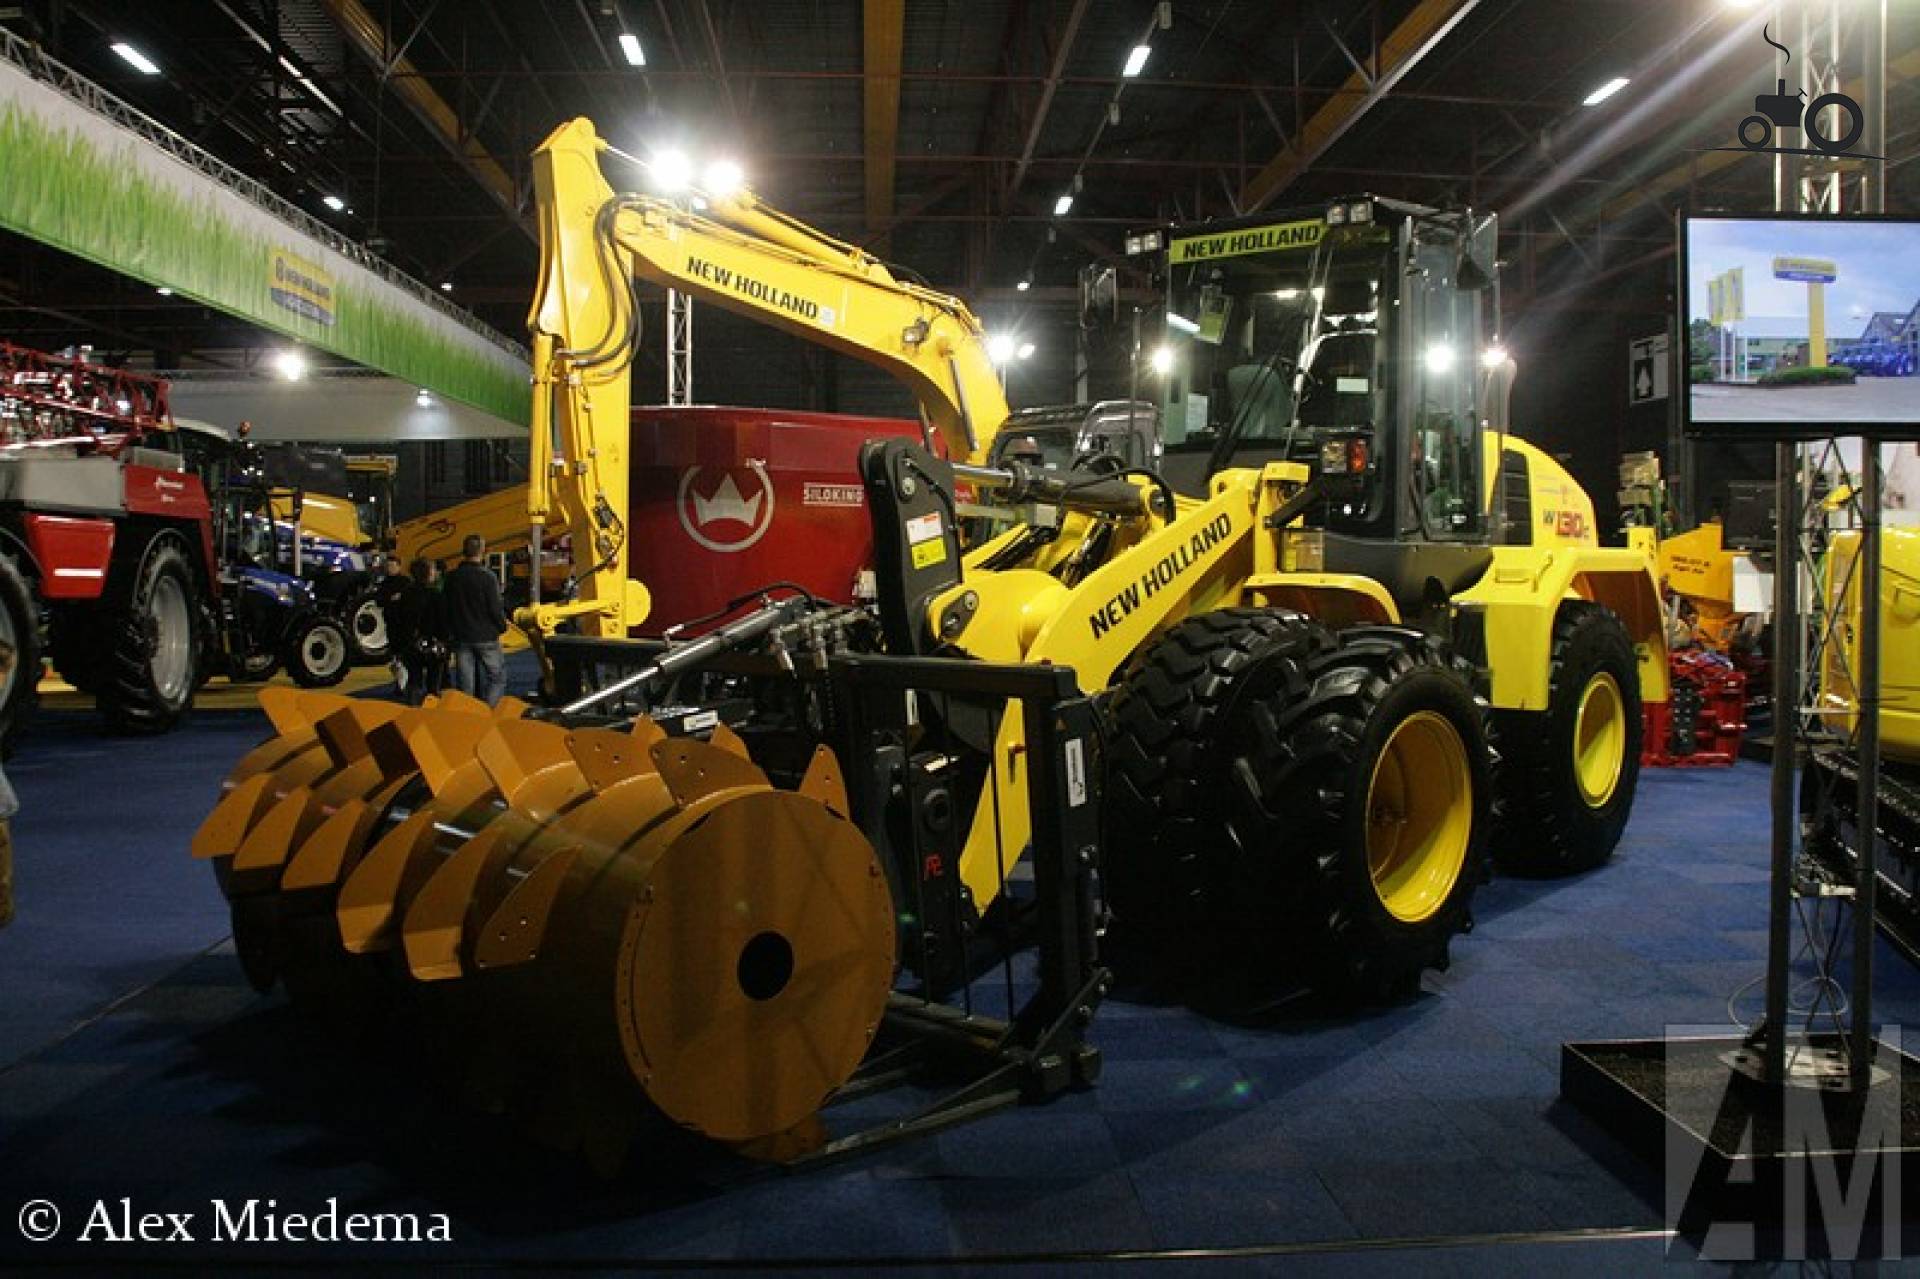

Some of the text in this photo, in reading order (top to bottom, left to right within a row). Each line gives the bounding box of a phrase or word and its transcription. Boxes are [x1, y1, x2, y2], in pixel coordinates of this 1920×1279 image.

[1183, 224, 1320, 258] NEW HOLLAND
[687, 256, 818, 319] NEW HOLLAND
[1089, 512, 1232, 640] NEW HOLLAND
